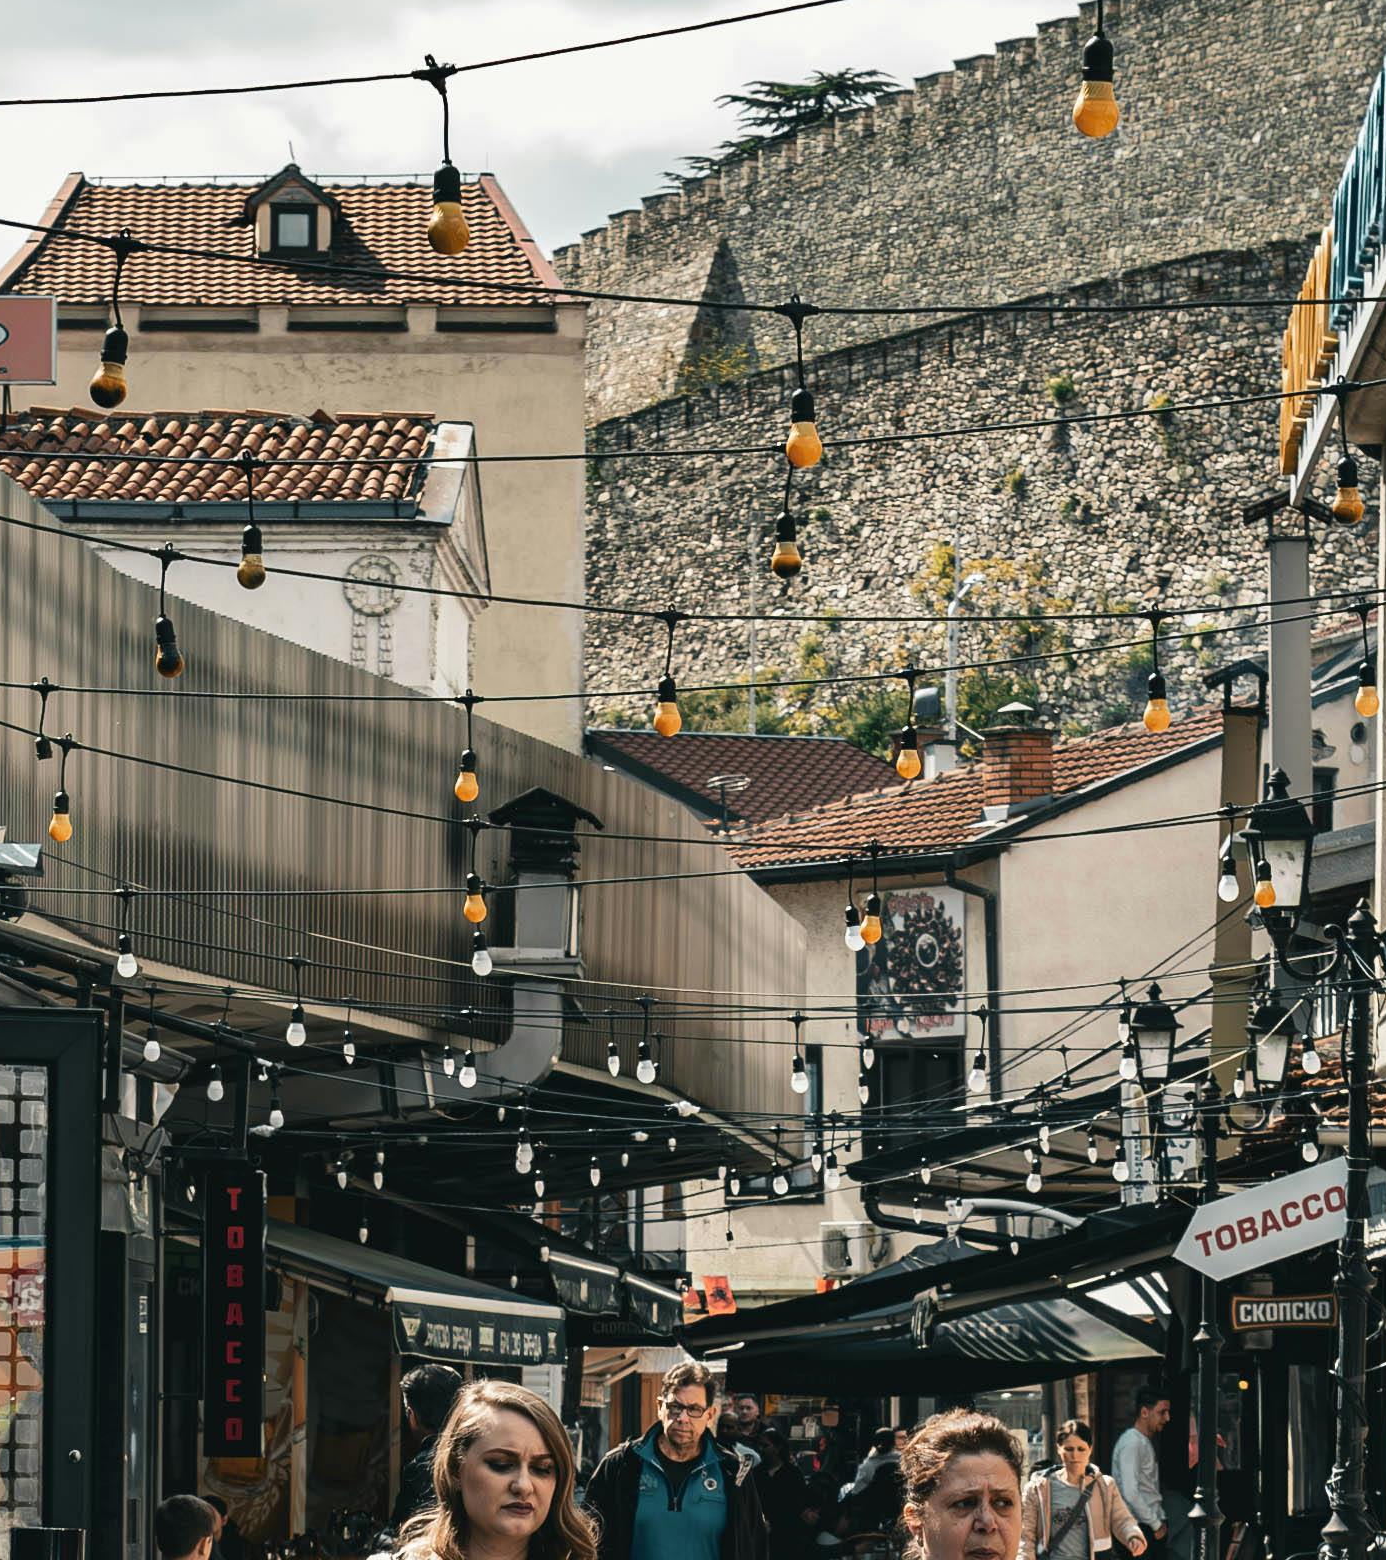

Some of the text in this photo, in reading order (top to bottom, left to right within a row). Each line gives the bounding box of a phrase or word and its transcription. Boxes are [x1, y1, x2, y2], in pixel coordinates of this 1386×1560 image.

[1194, 1185, 1348, 1257] TOBACCO
[225, 1187, 245, 1441] TOBACCO
[1239, 1301, 1330, 1322] СКОПСКО
